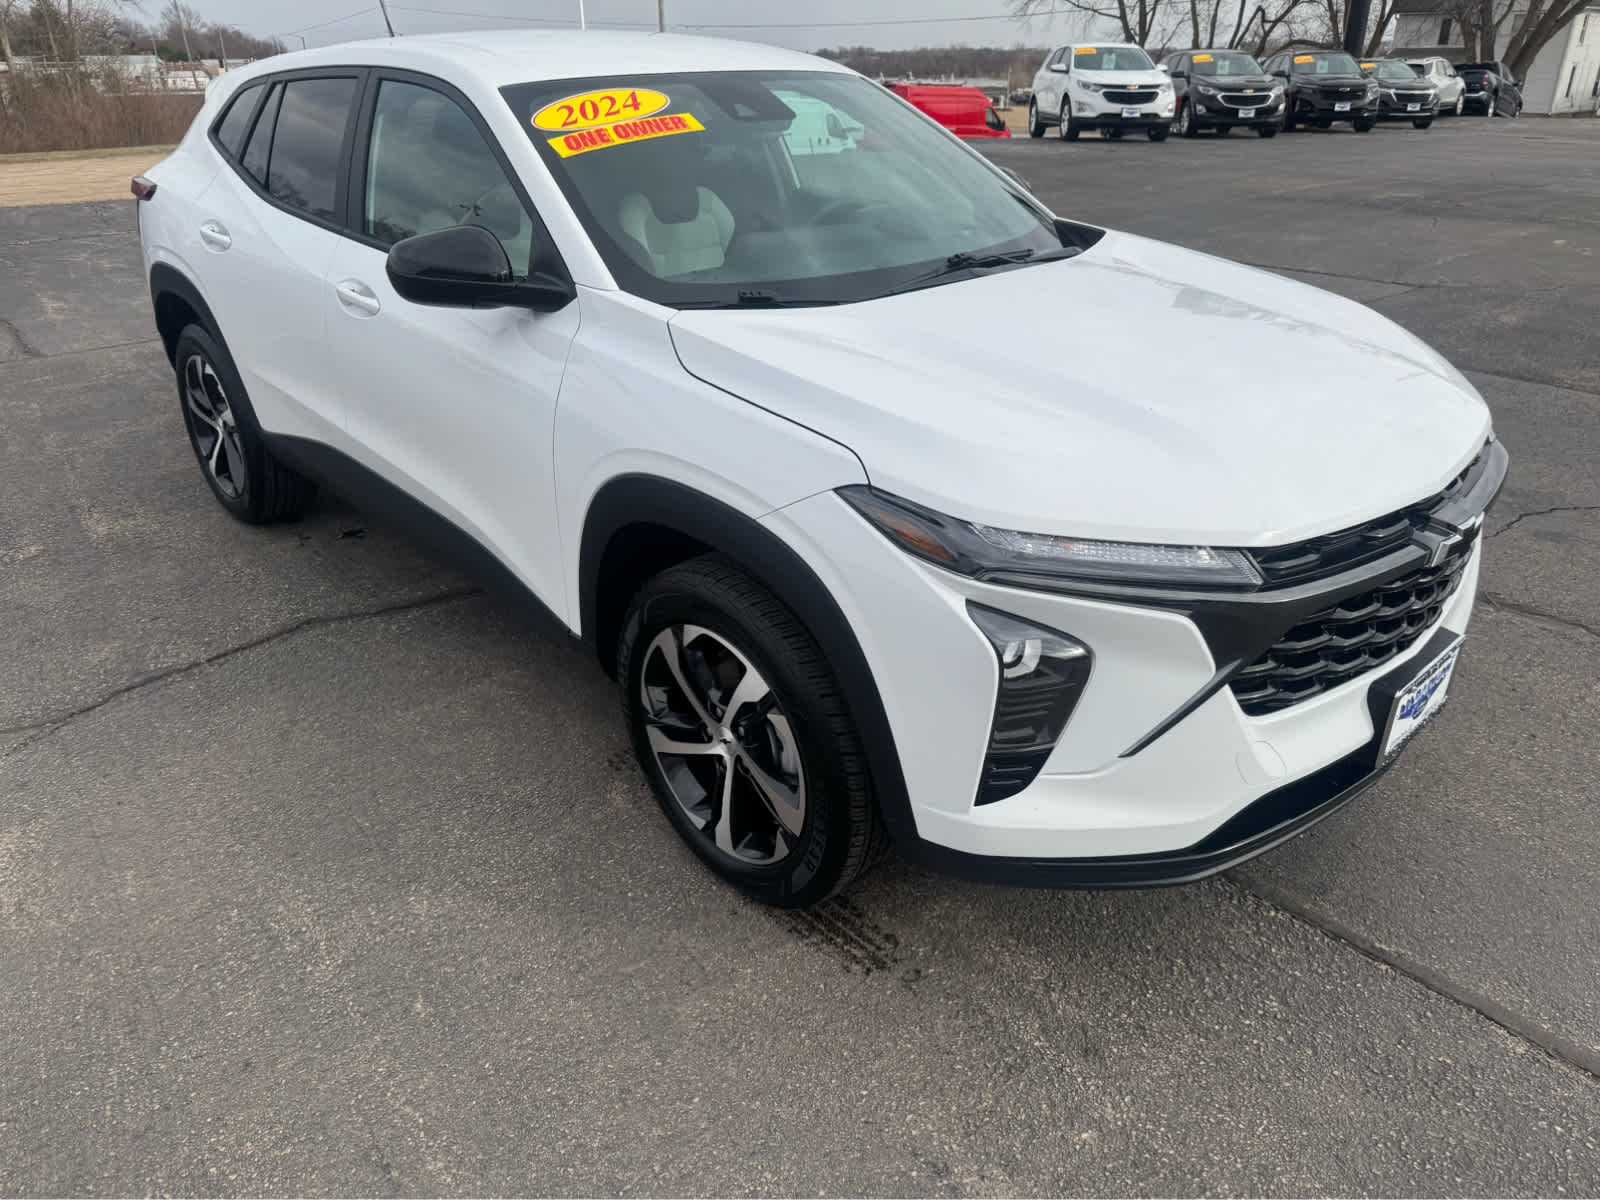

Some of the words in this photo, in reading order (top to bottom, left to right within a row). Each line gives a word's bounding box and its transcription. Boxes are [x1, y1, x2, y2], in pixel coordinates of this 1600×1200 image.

[557, 91, 641, 127] 2024
[564, 129, 613, 152] ONE
[614, 116, 687, 139] OWNER
